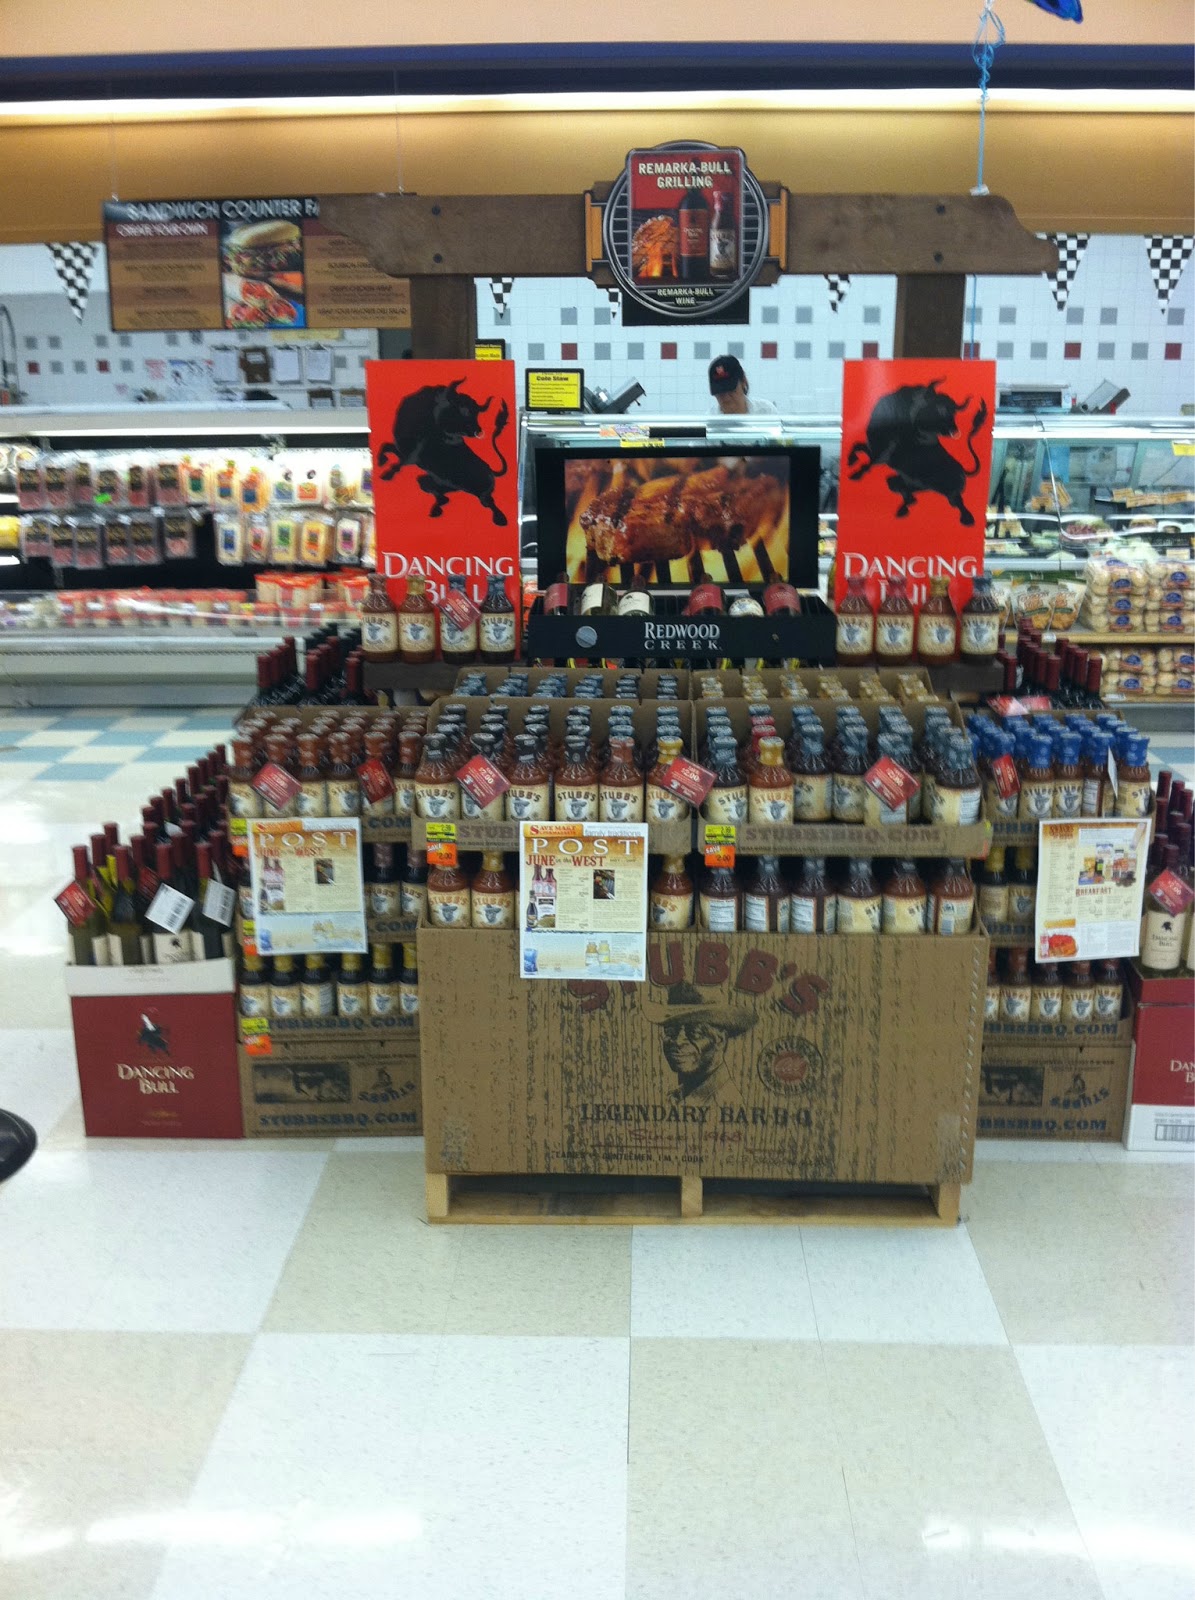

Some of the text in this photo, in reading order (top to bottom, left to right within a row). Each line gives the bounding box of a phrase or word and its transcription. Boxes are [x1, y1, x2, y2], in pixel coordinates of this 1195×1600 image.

[638, 161, 732, 175] REMARKA-BULL
[656, 175, 714, 189] GRILLING
[126, 201, 220, 221] SANDWICH
[221, 199, 302, 218] COUNTER
[657, 288, 714, 297] REMARKA-BULL
[675, 297, 696, 305] WINE
[381, 551, 514, 579] DANCING
[842, 552, 978, 579] DANCING
[644, 622, 720, 639] REDWOOD
[416, 788, 456, 800] STUBB'S
[557, 791, 597, 801] STUBB'S
[600, 791, 638, 803] STUBB'S
[259, 832, 354, 848] POST
[532, 838, 638, 856] POST
[526, 855, 556, 866] JUNE
[571, 856, 606, 867] WEST
[567, 941, 830, 1015] UBB'S
[116, 1063, 195, 1080] DANCING
[139, 1080, 180, 1095] BULL
[579, 1103, 711, 1123] LEGENDARY
